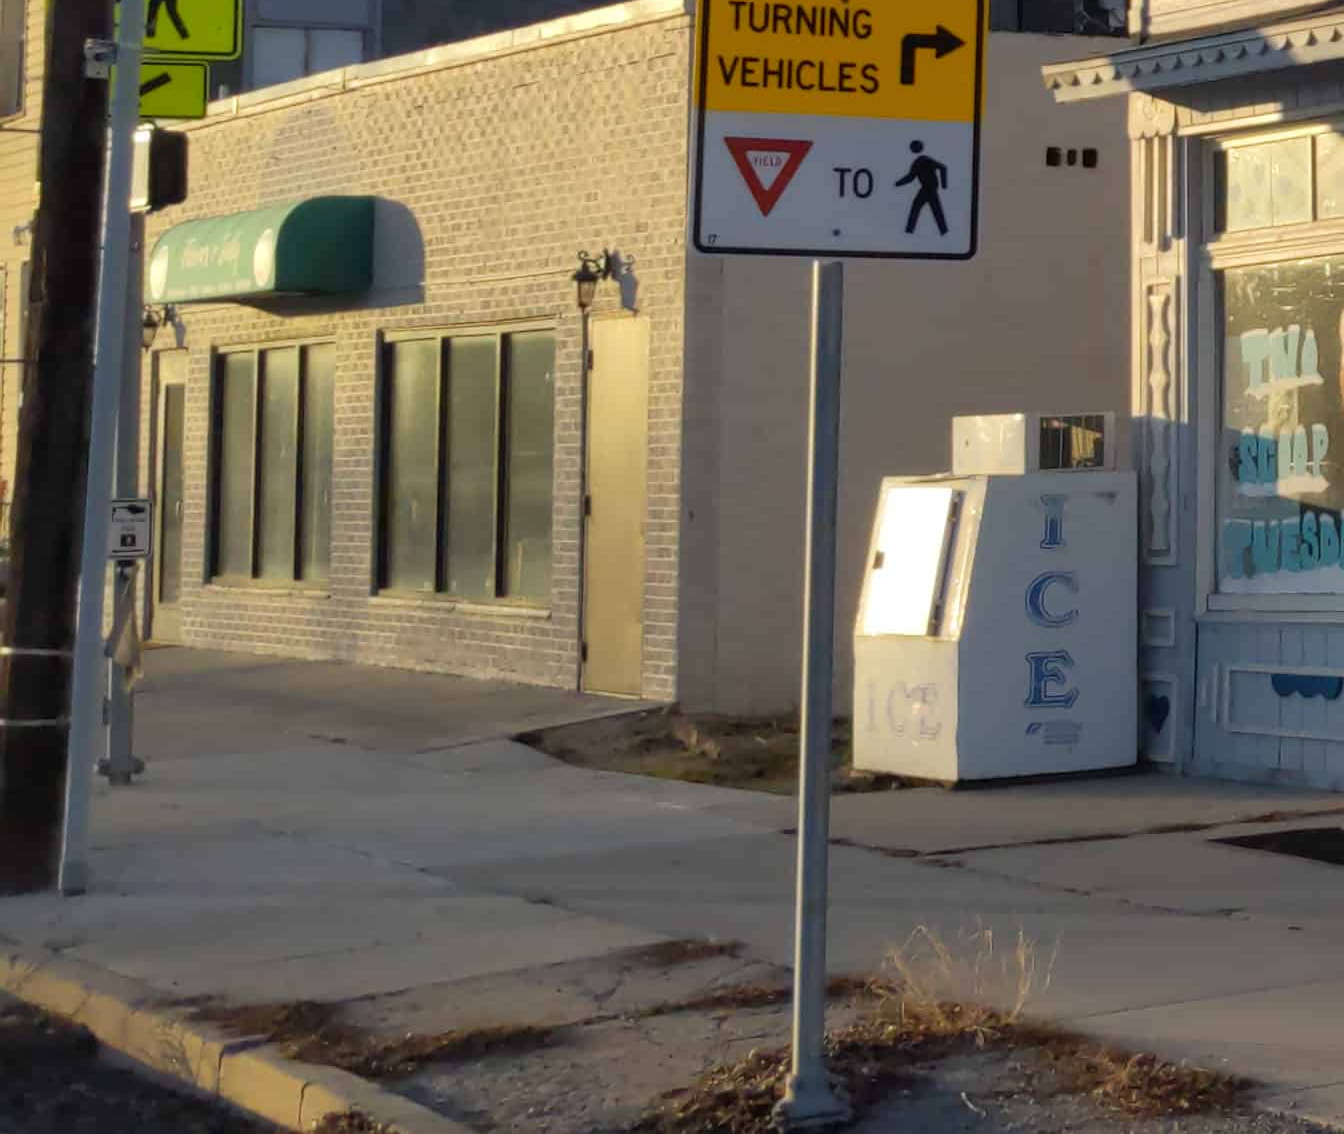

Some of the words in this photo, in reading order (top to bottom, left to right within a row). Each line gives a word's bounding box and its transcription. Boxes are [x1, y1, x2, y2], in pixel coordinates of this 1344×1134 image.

[728, 1, 873, 40] TURNING
[717, 56, 880, 94] VEHICLES
[753, 155, 783, 168] YIELD
[832, 167, 874, 199] TO
[1024, 494, 1080, 709] ICE
